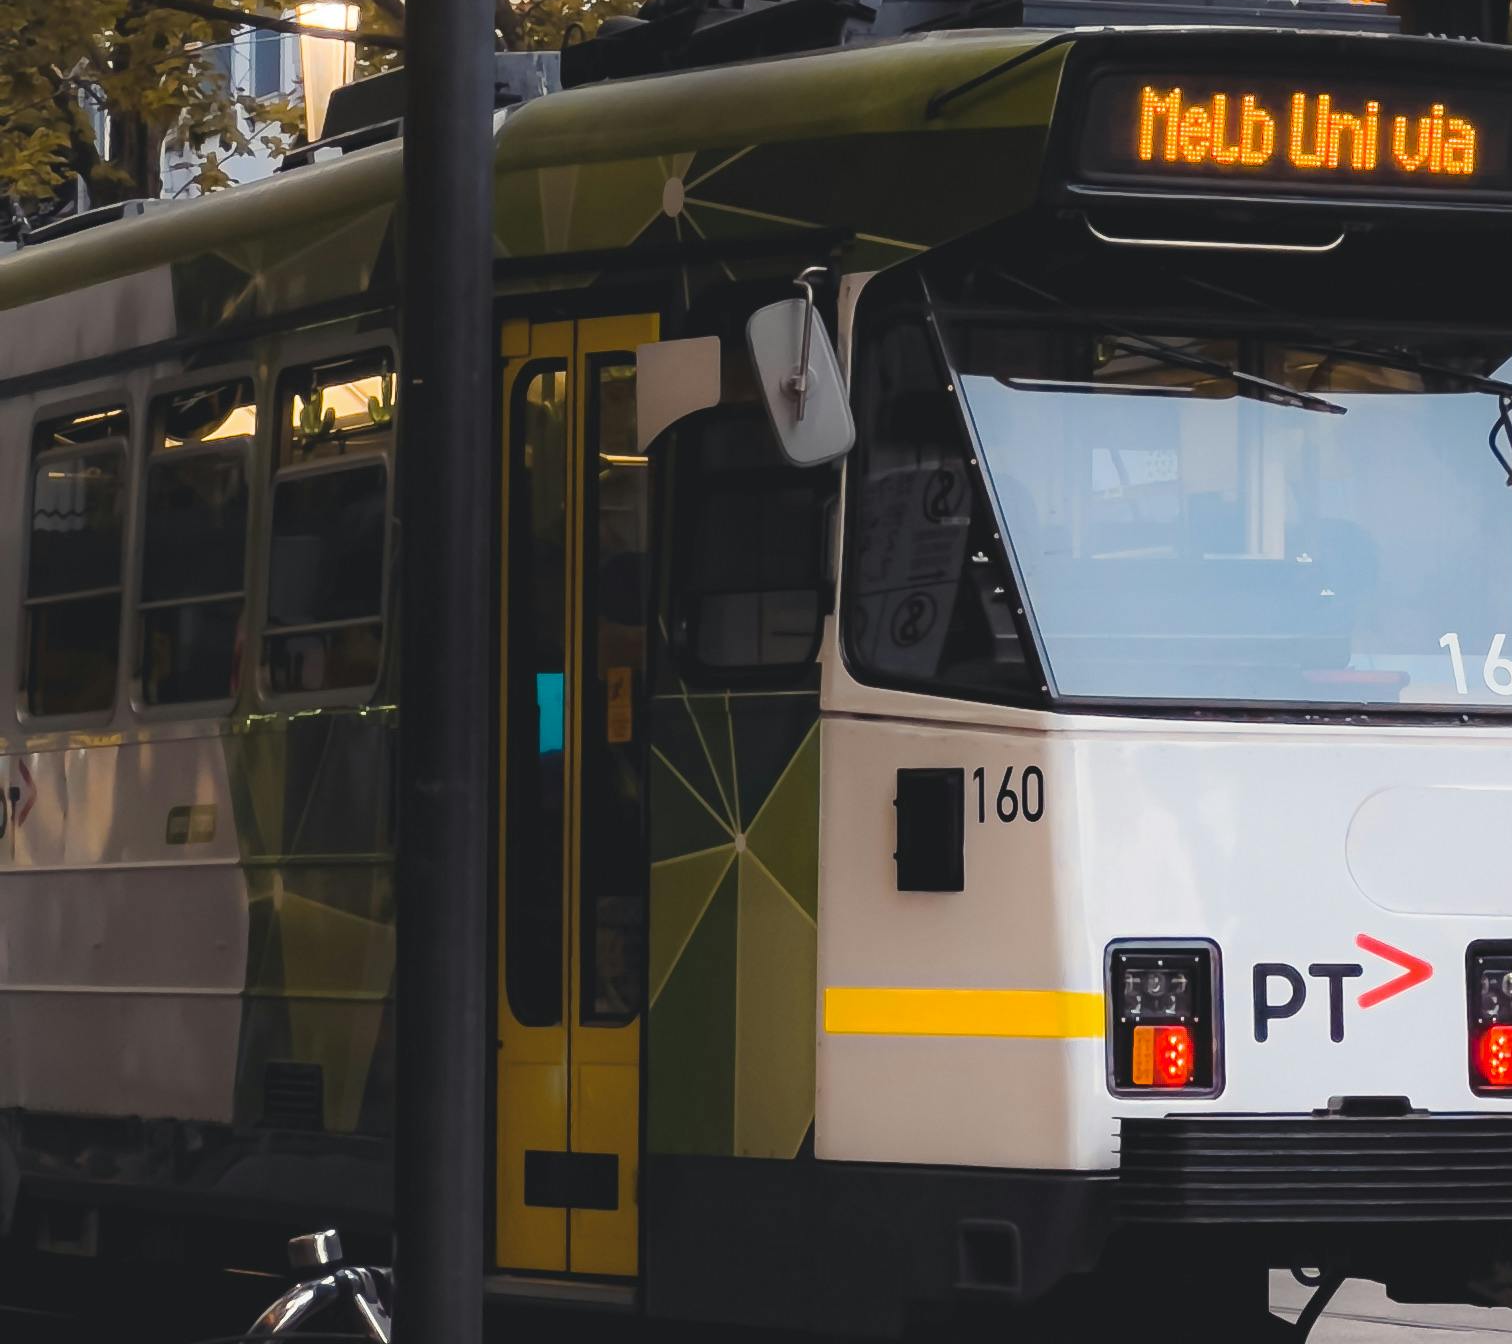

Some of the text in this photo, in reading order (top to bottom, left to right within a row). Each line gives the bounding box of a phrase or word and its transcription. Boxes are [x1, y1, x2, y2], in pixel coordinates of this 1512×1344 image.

[1138, 85, 1477, 176] Melb Uni via
[972, 765, 1045, 824] 160
